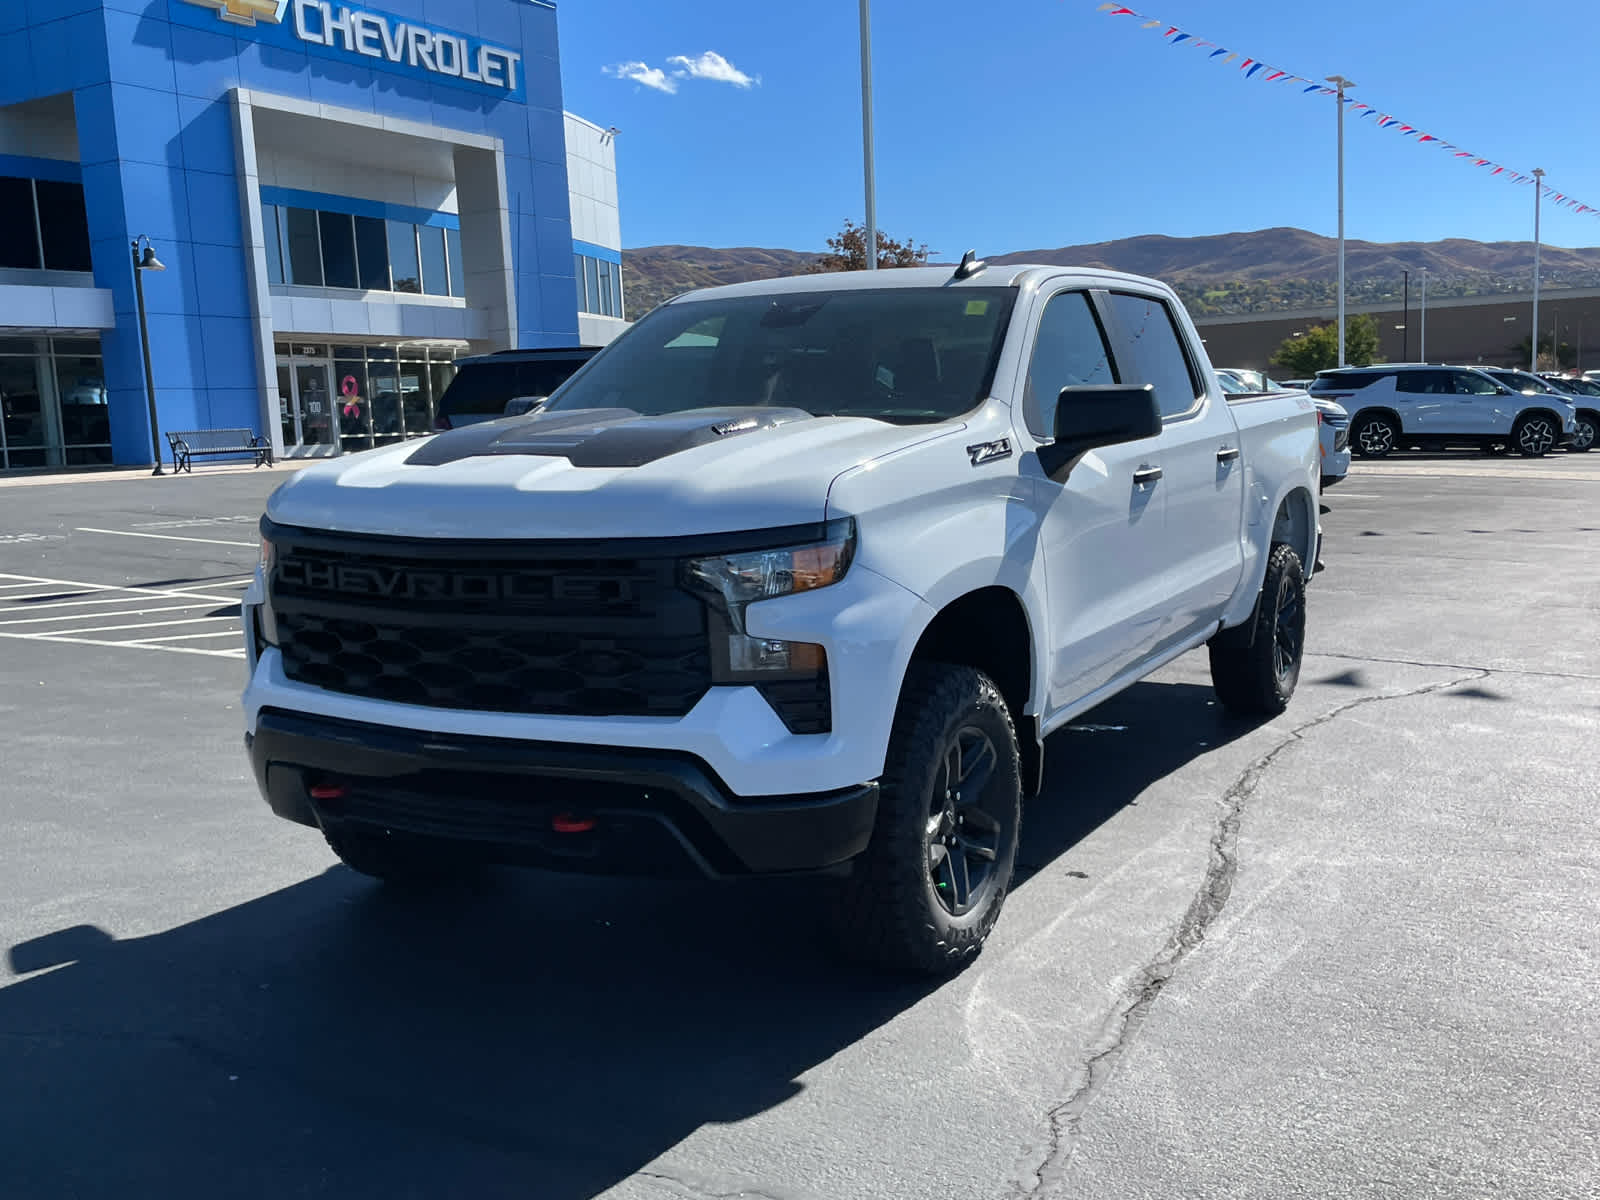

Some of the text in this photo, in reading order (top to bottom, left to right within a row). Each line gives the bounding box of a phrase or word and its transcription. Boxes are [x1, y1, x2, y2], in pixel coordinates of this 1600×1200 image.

[293, 0, 520, 90] CHEVROLET
[966, 437, 1012, 466] Z71
[275, 559, 655, 600] CHEVROLET
